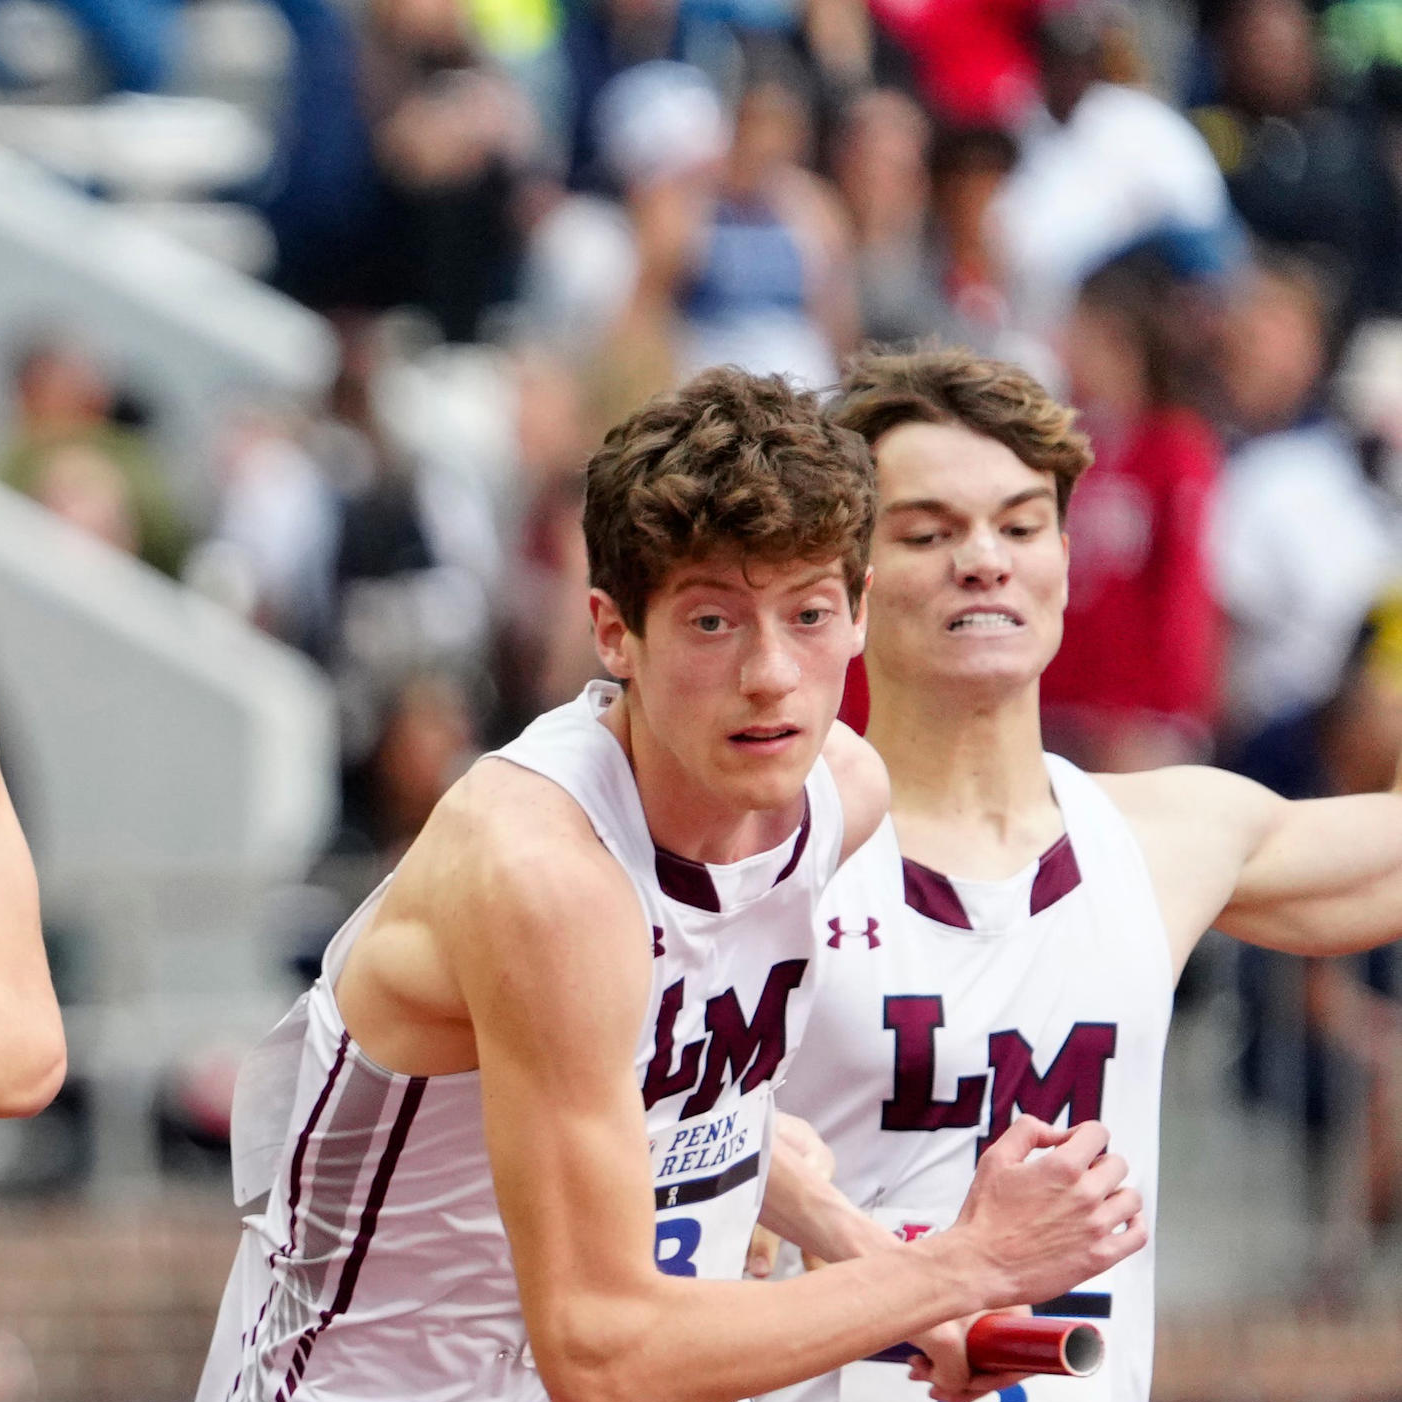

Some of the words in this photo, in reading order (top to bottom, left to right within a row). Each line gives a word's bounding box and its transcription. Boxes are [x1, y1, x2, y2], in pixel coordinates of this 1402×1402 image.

[642, 958, 809, 1122] LM
[881, 993, 1117, 1170] LM
[656, 1129, 748, 1178] RELAYS
[668, 1111, 739, 1152] PENN
